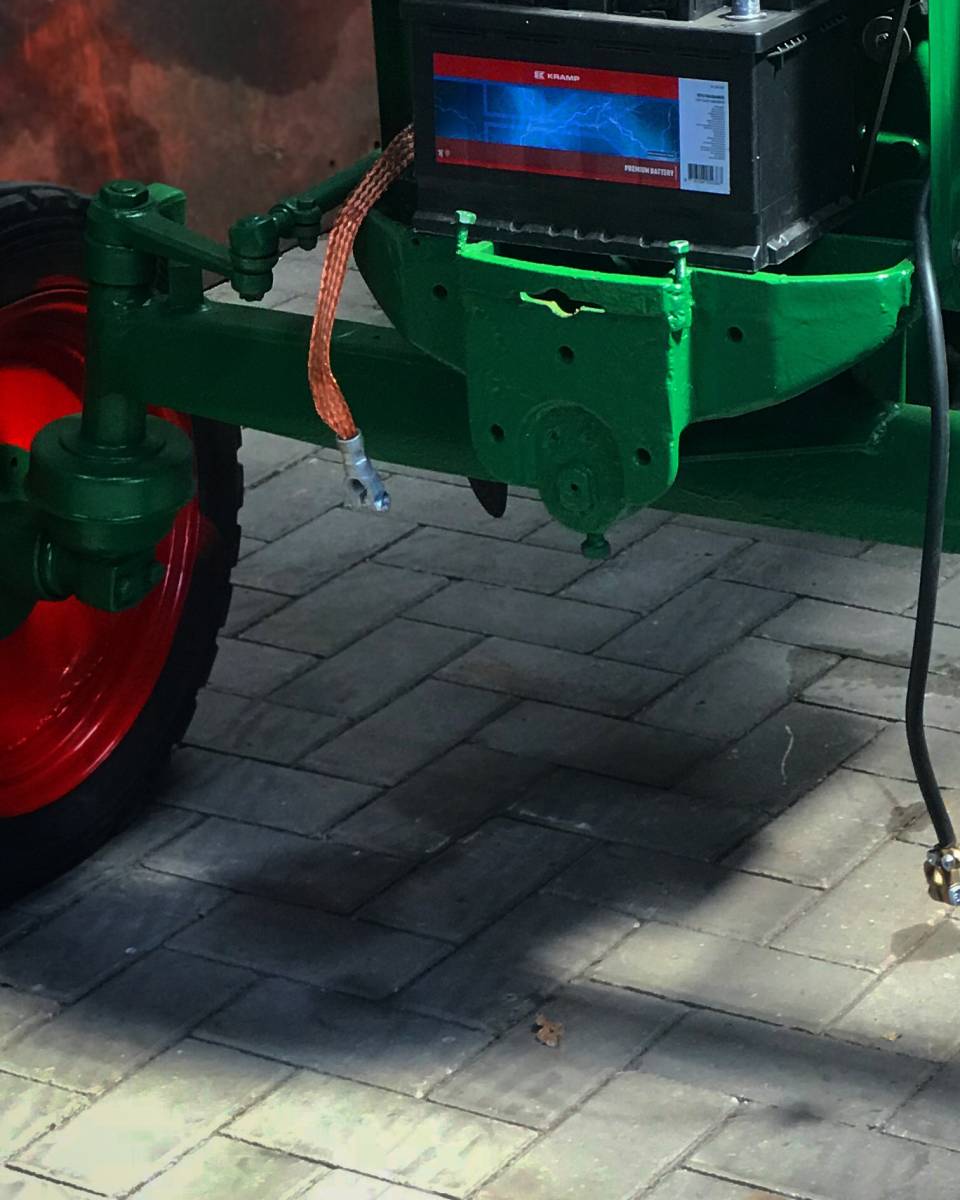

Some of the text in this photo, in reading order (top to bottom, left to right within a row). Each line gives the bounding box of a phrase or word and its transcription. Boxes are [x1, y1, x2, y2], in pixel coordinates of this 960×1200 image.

[547, 72, 581, 82] KRAMP
[624, 164, 674, 177] PREMIUM BATTERY
